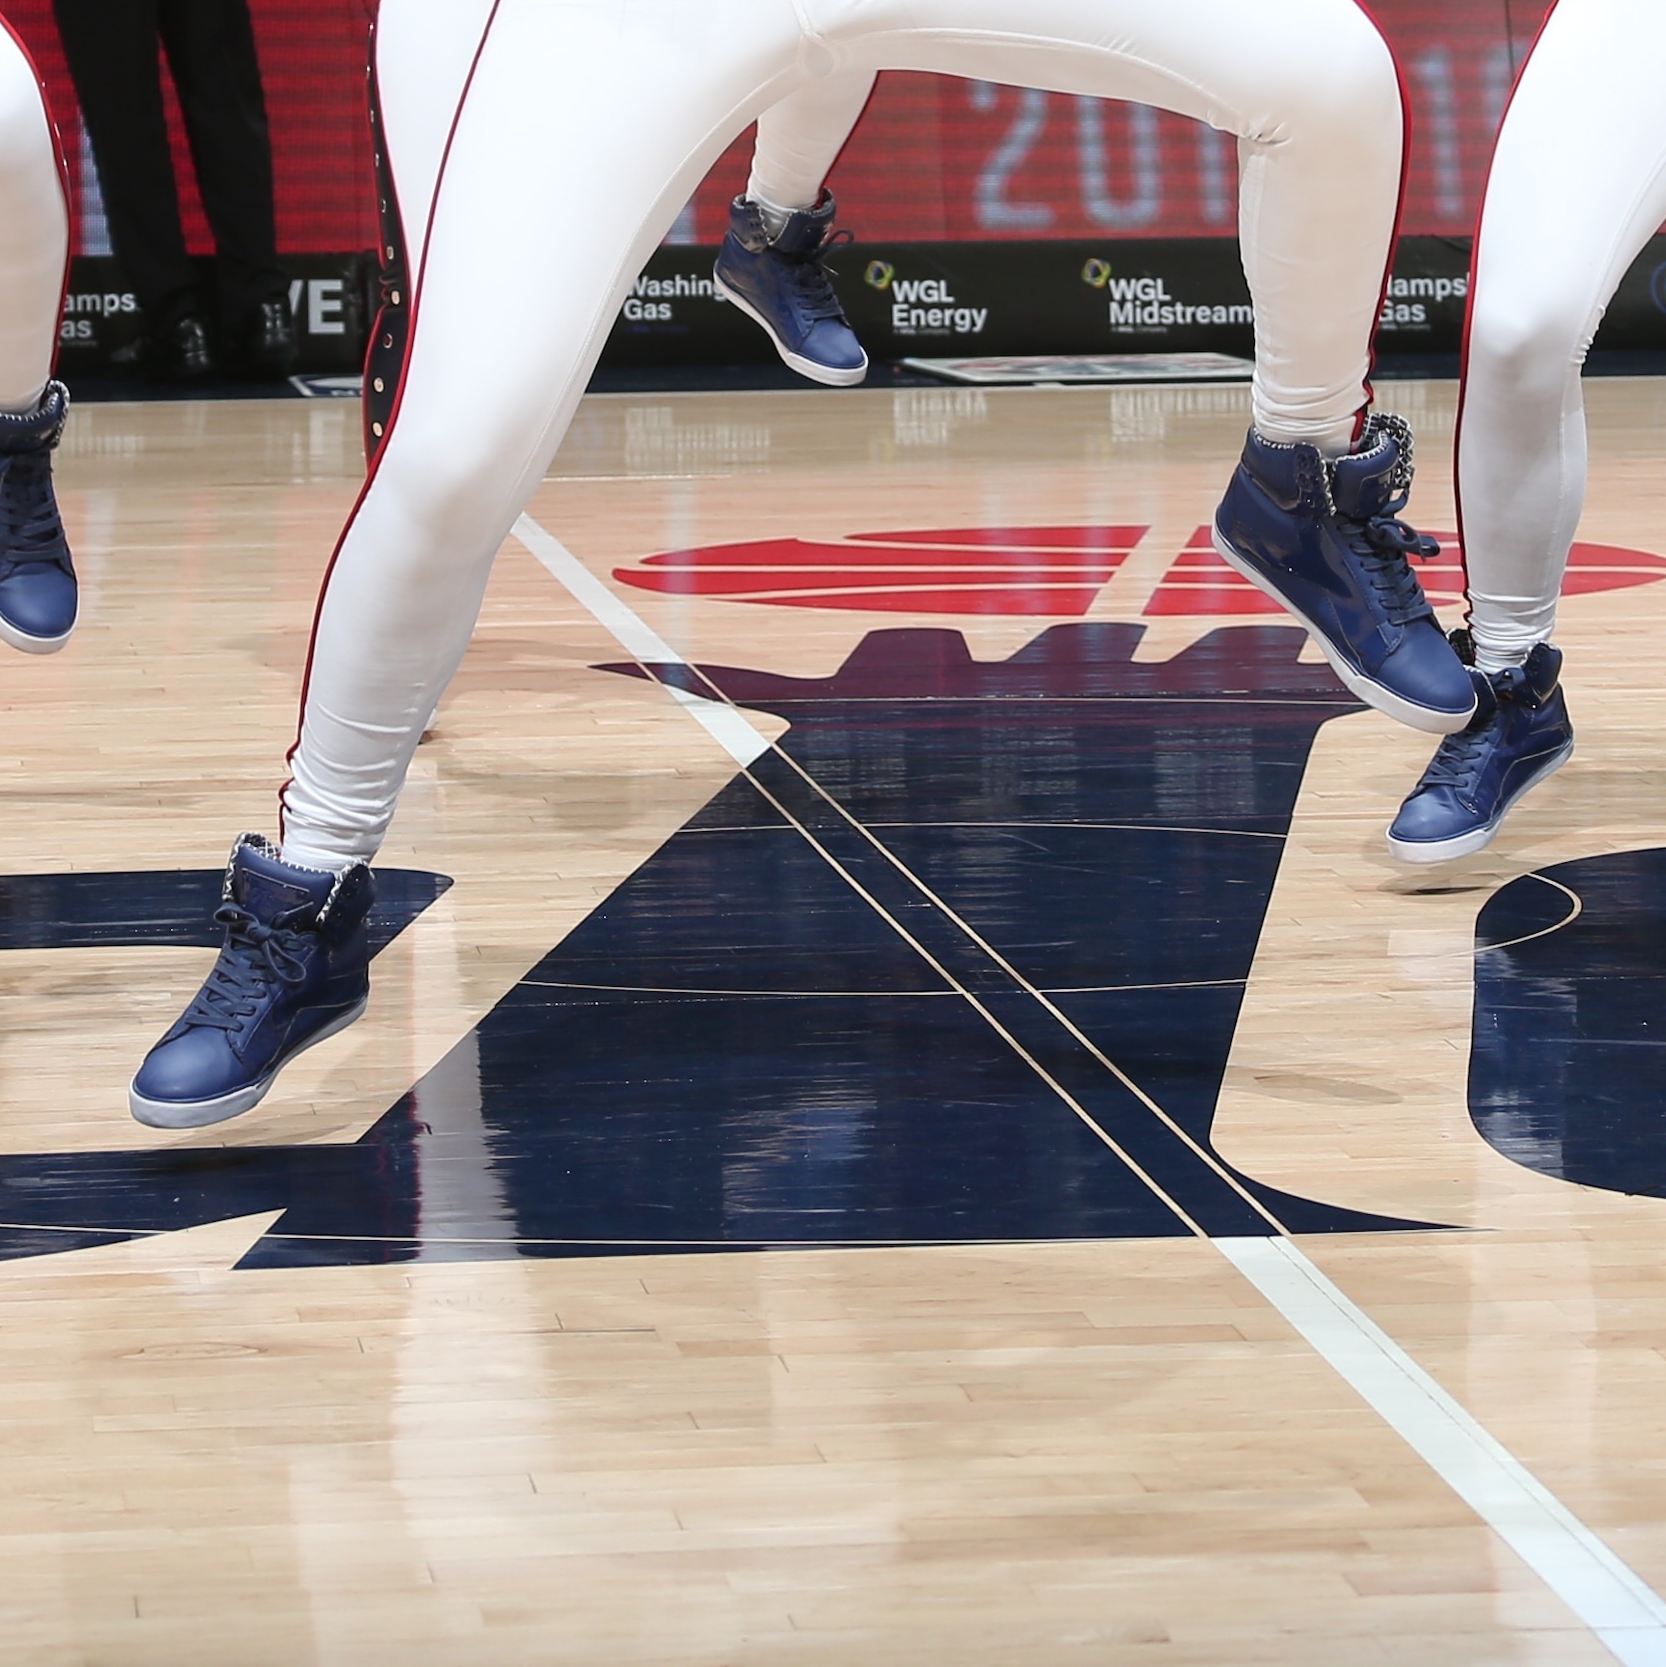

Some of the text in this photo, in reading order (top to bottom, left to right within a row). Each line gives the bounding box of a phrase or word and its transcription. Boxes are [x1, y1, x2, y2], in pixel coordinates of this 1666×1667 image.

[892, 280, 955, 304] WGL
[1109, 279, 1171, 302] WGL
[623, 298, 673, 322] Gas
[892, 304, 988, 333] Energy
[1109, 300, 1252, 324] Midstream
